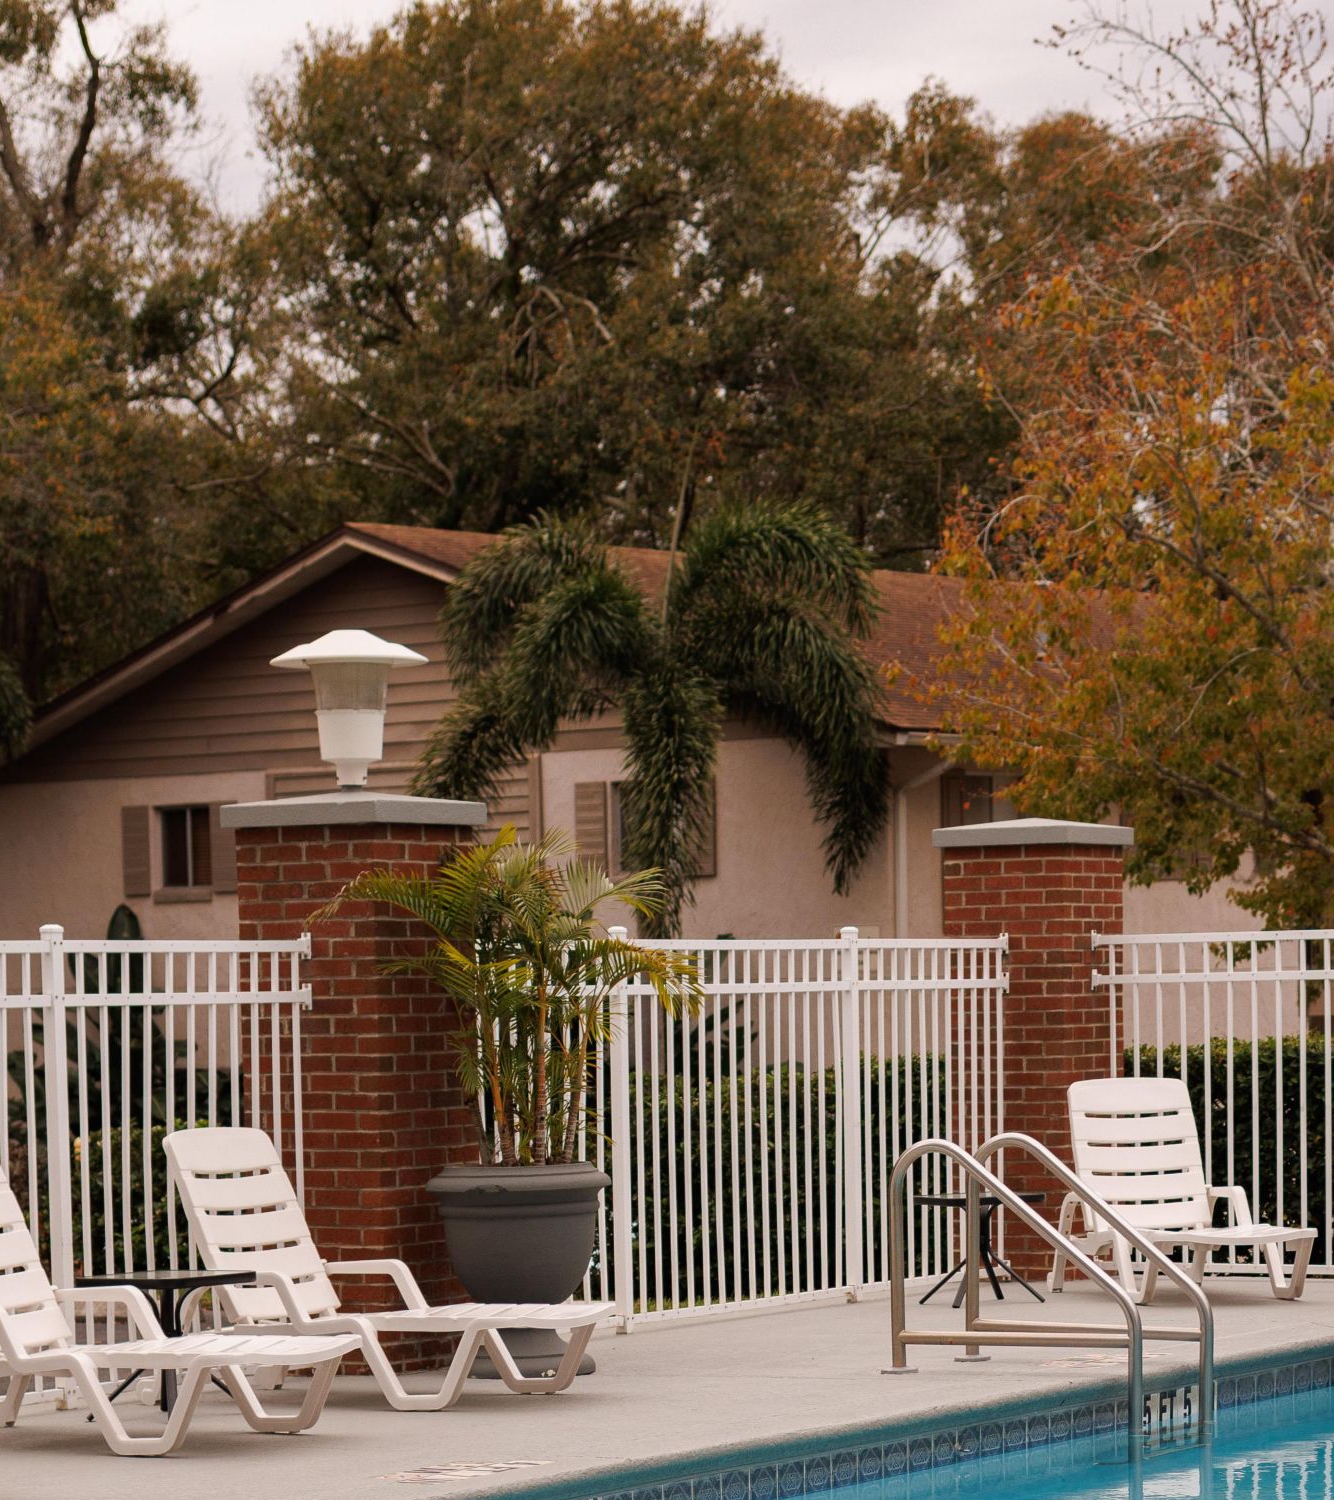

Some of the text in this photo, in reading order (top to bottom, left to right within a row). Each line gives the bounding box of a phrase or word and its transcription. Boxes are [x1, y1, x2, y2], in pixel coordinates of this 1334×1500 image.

[1143, 1393, 1151, 1425] 5
[1159, 1389, 1177, 1421] FT
[1183, 1386, 1192, 1417] 5
